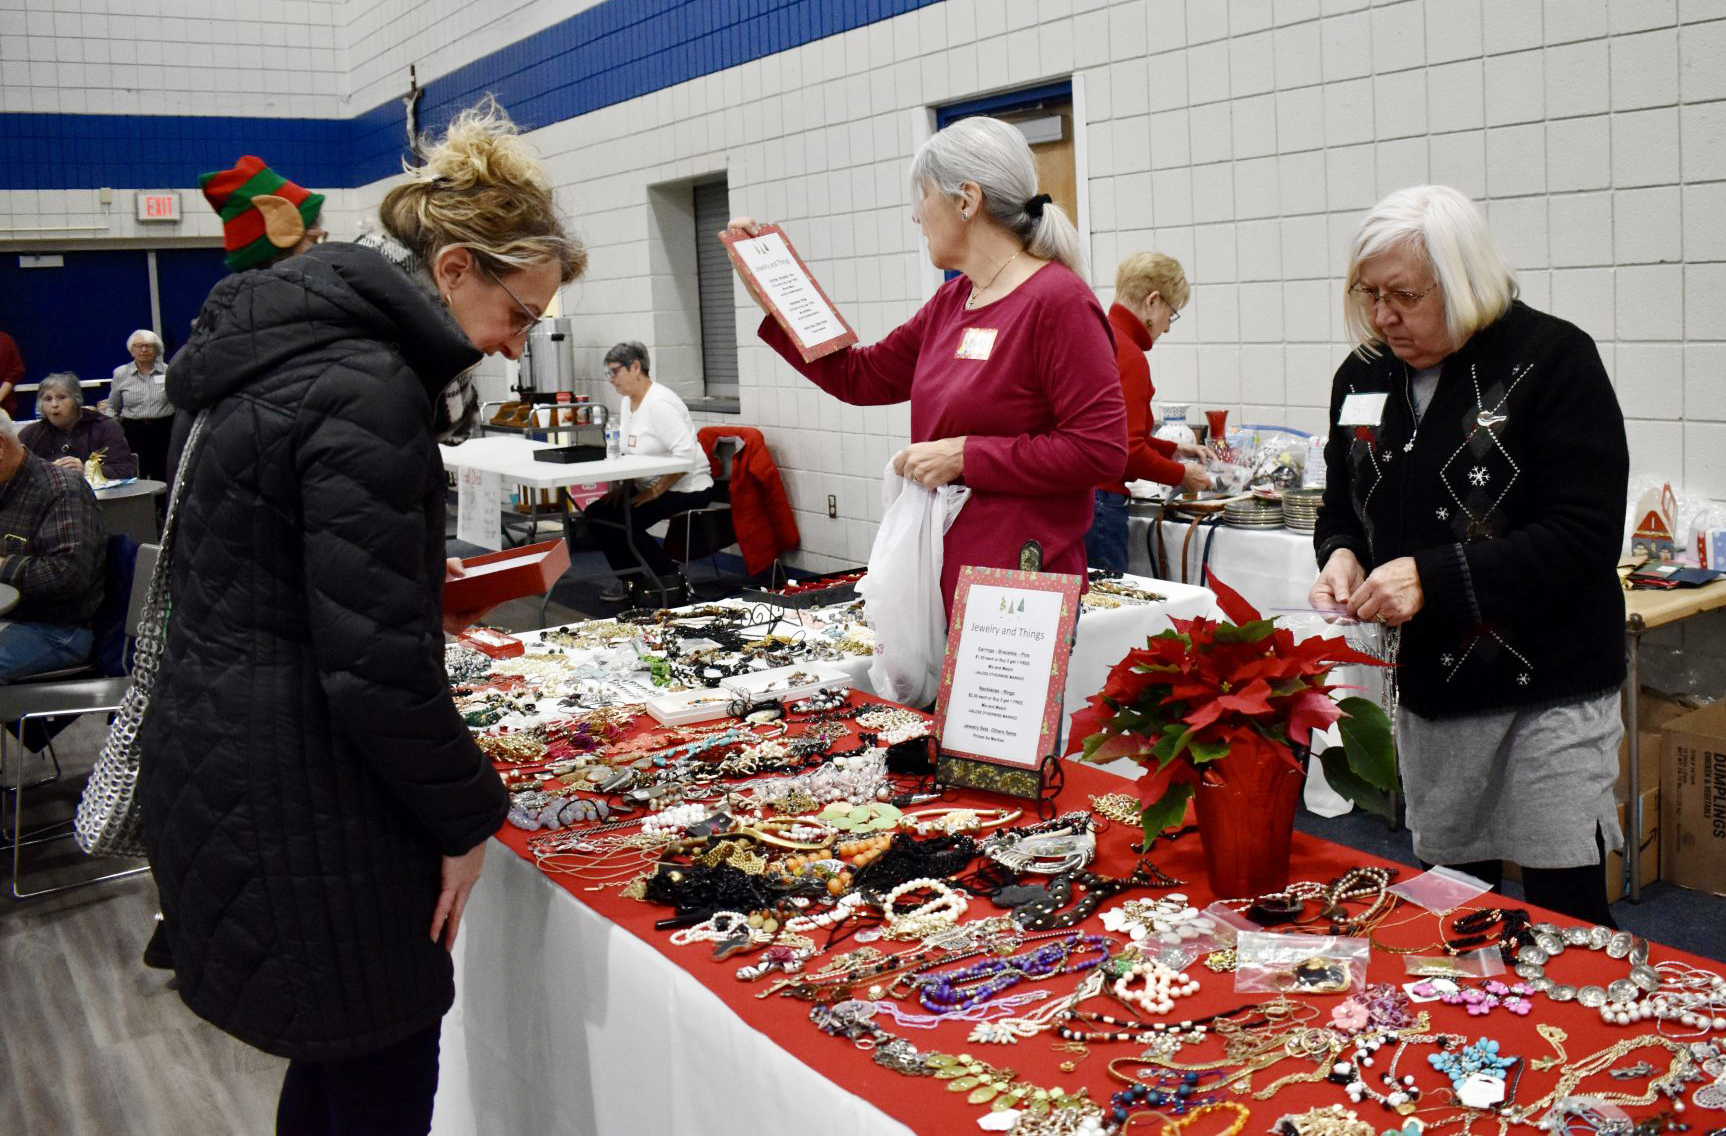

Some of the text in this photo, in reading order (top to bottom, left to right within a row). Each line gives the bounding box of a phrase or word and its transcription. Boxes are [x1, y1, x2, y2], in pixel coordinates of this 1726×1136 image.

[146, 195, 173, 217] EXIT
[971, 622, 1045, 642] Jewelry and Things
[1712, 752, 1726, 839] DUMPLINGS
